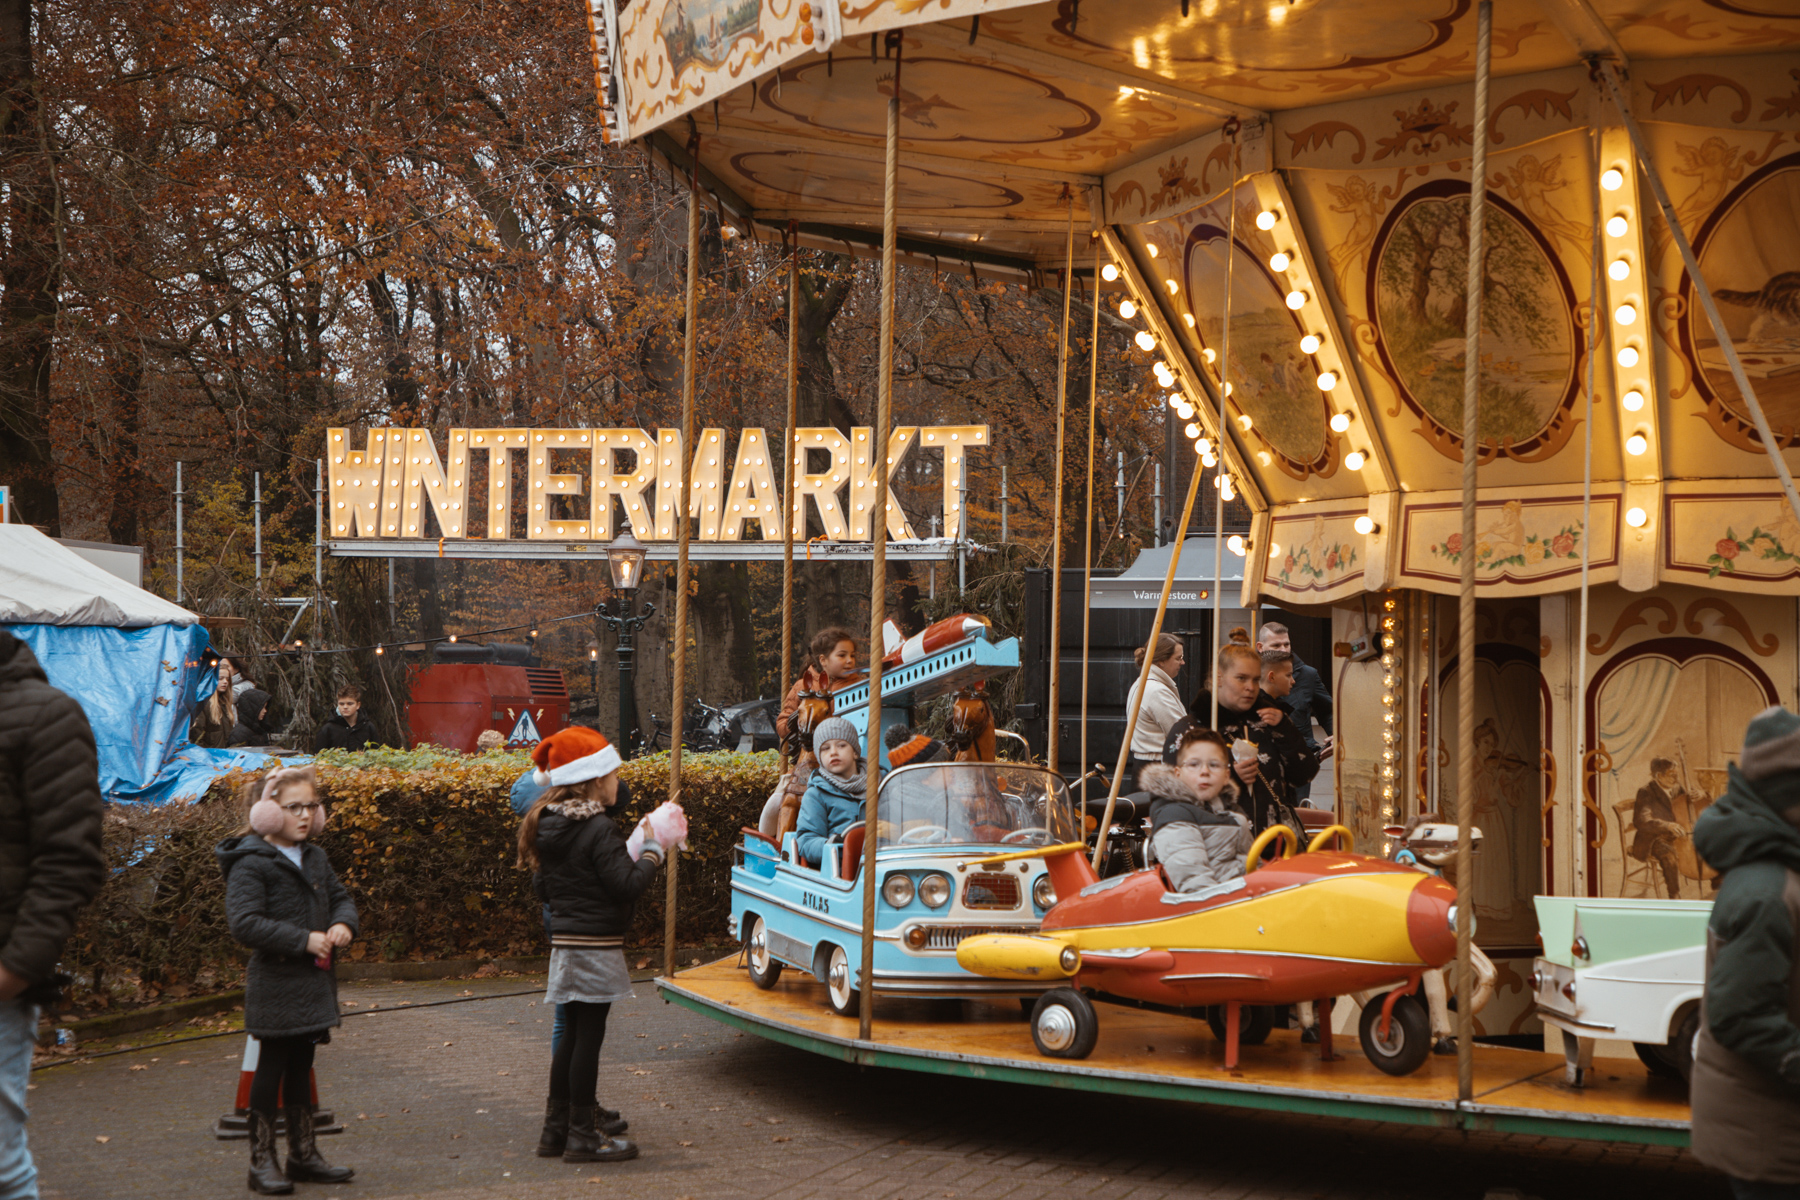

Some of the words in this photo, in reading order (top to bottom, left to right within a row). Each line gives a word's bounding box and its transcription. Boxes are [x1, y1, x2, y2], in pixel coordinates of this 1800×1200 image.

[326, 424, 990, 541] WINTERMARKT
[1133, 590, 1197, 599] Warmestore
[802, 891, 829, 914] ATLAS
